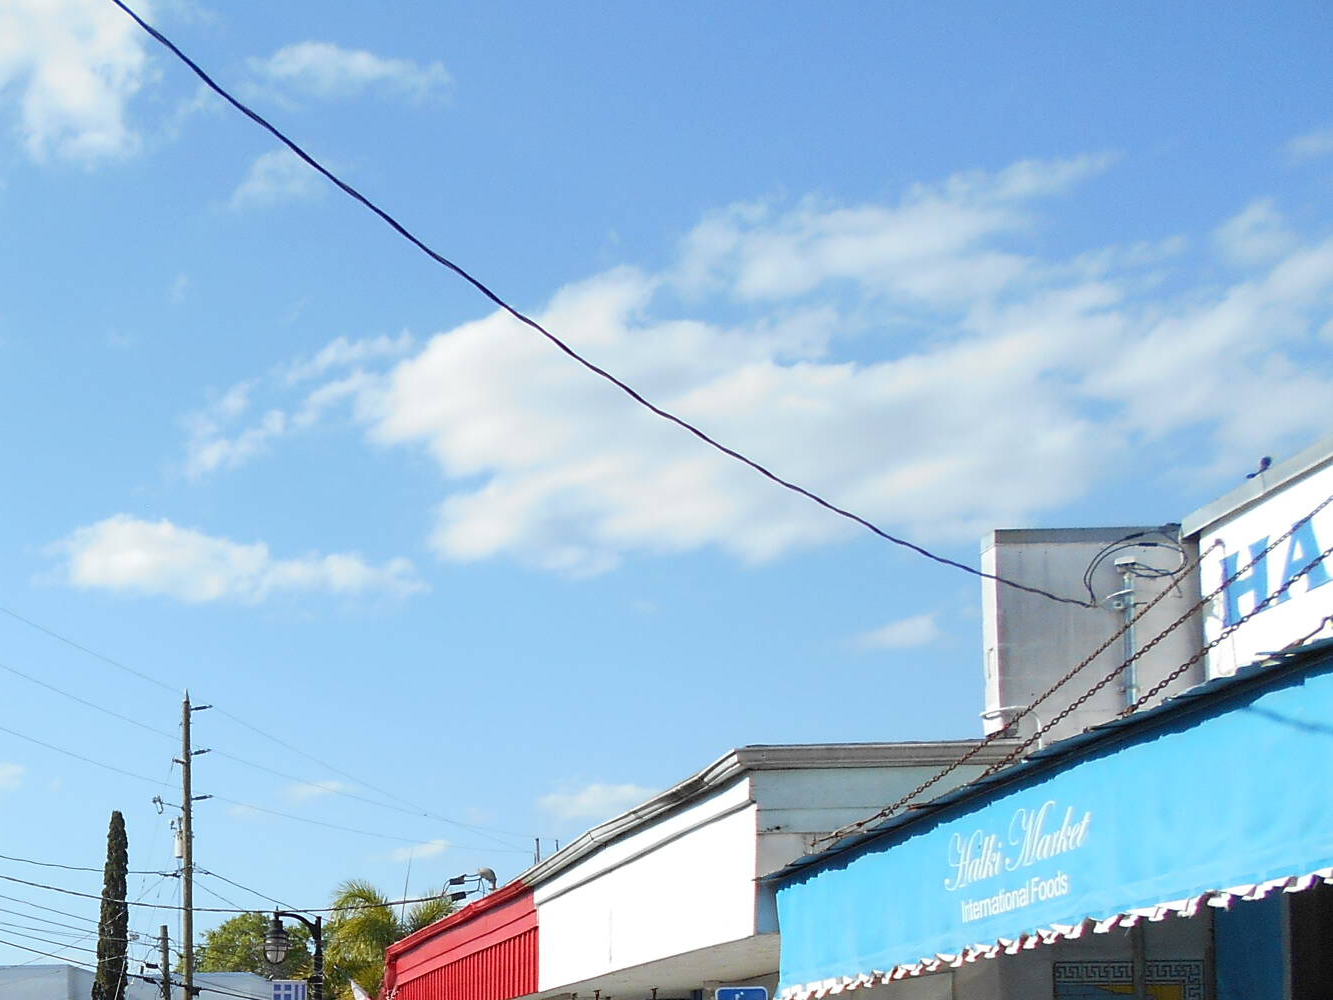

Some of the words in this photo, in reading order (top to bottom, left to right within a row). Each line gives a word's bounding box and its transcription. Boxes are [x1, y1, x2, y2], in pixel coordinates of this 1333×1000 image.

[944, 830, 1003, 891] Halki
[1005, 800, 1092, 872] Market
[961, 880, 1030, 924] International
[1031, 870, 1069, 904] Foods
